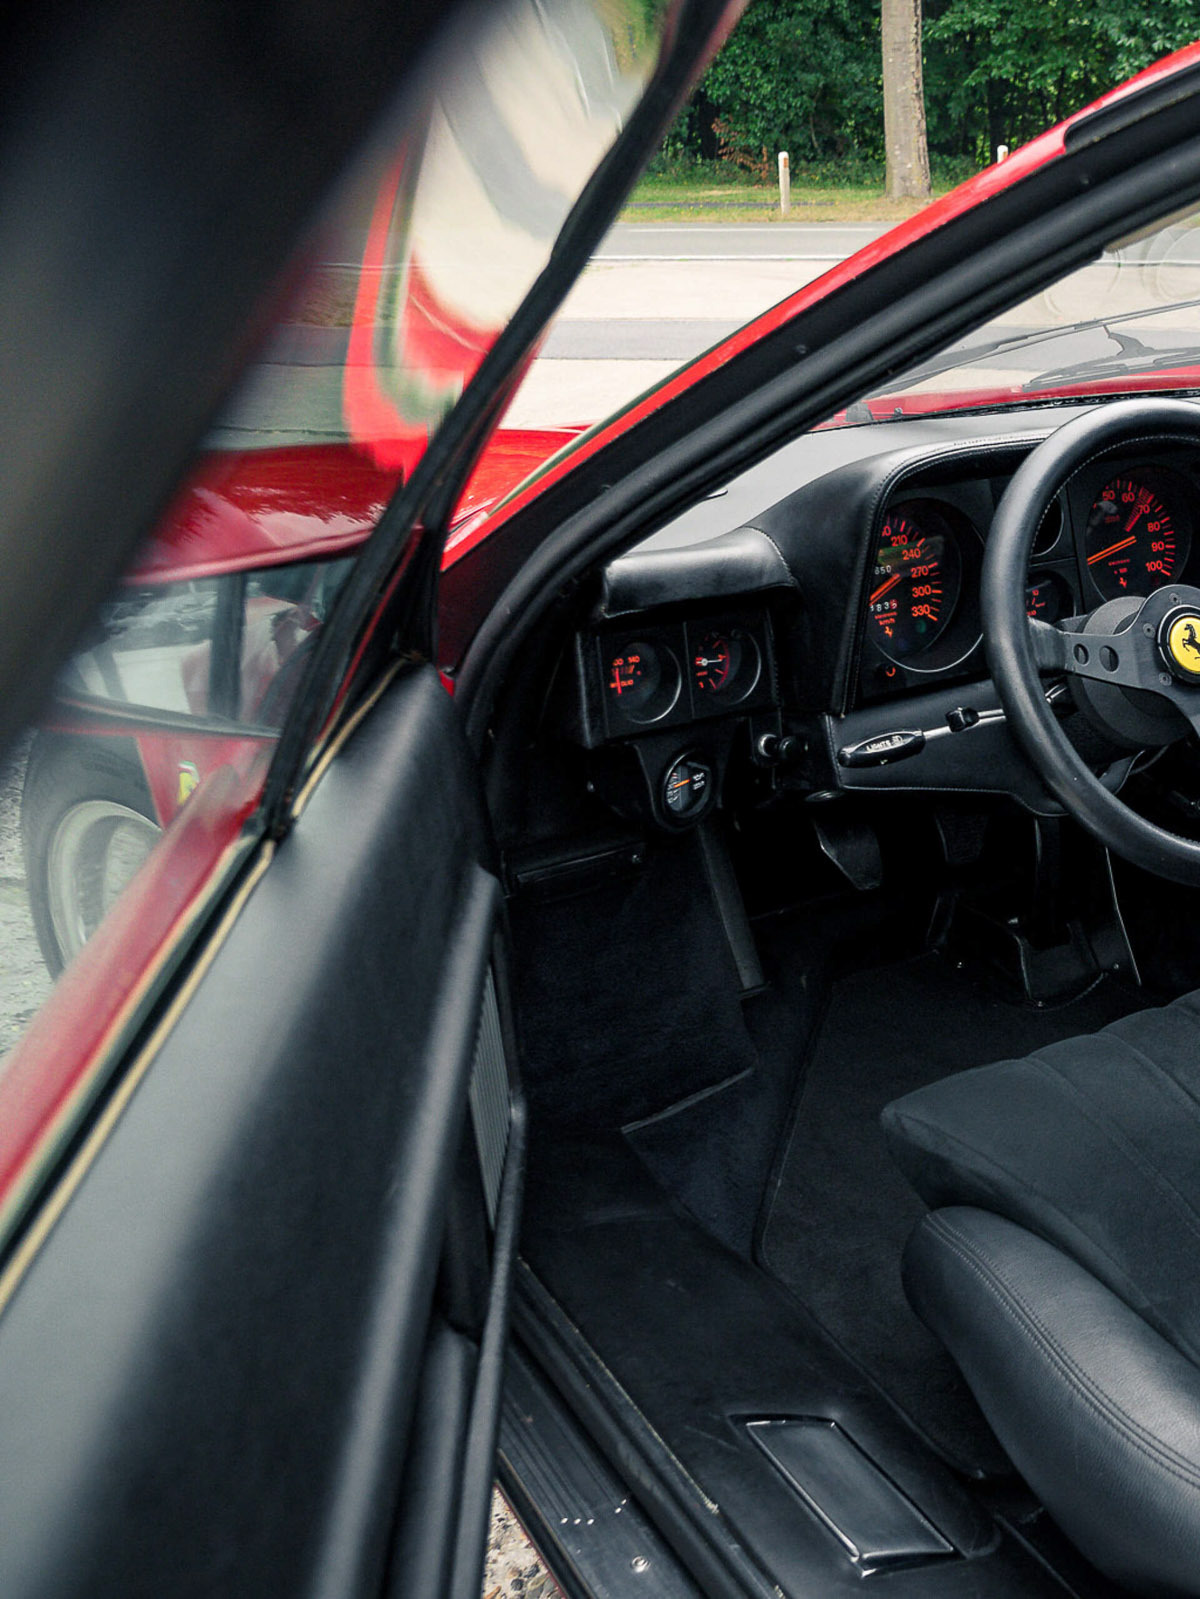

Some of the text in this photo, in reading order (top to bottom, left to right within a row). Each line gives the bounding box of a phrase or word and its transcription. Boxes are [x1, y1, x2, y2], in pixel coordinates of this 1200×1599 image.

[1122, 492, 1135, 503] 60
[1139, 504, 1150, 514] 70
[1148, 521, 1160, 532] 80
[891, 534, 908, 547] 210
[1152, 541, 1164, 552] 90
[902, 548, 921, 560] 240
[911, 565, 929, 578] 270
[1146, 560, 1163, 573] 100
[912, 585, 931, 598] 300
[911, 604, 930, 617] 330
